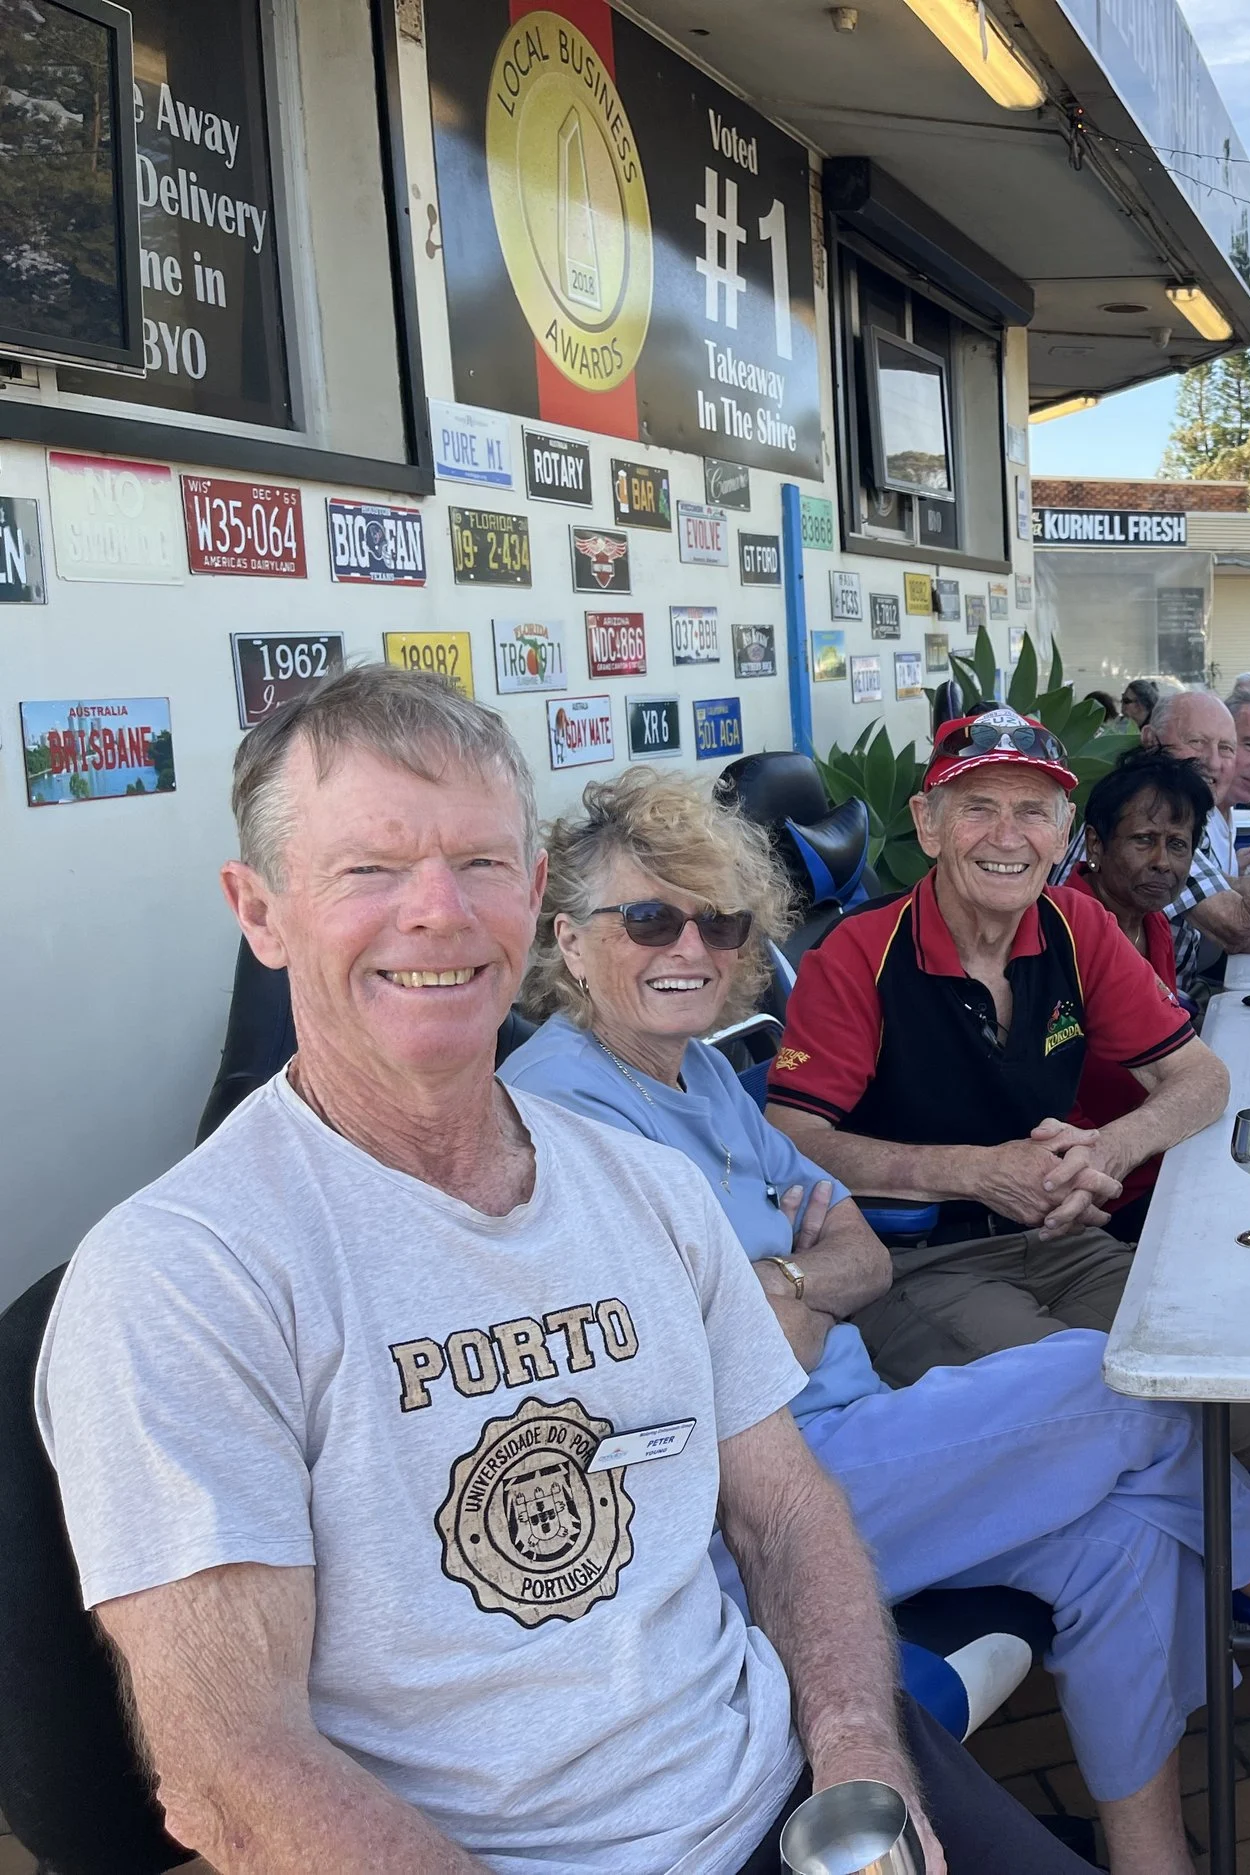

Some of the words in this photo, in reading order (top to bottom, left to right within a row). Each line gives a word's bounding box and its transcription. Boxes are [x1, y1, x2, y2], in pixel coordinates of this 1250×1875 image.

[156, 83, 240, 169] Away
[497, 31, 550, 118] LOCAL
[559, 30, 638, 184] BUSINESS
[708, 109, 759, 175] Voted
[138, 154, 267, 254] Delivery
[194, 251, 227, 308] in
[571, 269, 595, 296] 2018
[695, 166, 793, 361] #1
[143, 318, 208, 380] BYO
[545, 318, 623, 380] AWARDS
[704, 339, 786, 408] Takeaway
[697, 390, 717, 431] In
[720, 397, 753, 436] The
[756, 406, 798, 452] Shire
[442, 428, 479, 467] PURE
[533, 448, 584, 490] ROTARY
[84, 467, 145, 518] NO
[252, 487, 272, 501] DEC
[631, 477, 655, 512] BAR
[332, 513, 370, 568] BIG
[383, 518, 423, 571] FAN
[469, 511, 514, 532] FLORIDA
[1044, 511, 1126, 541] KURNELL
[1128, 516, 1186, 542] FRESH
[250, 558, 296, 573] DAIRYLAND
[743, 545, 755, 572] GT
[756, 546, 777, 573] FORD
[259, 642, 330, 681] 1962
[69, 705, 129, 718] AUSTRALIA
[642, 709, 660, 745] XR
[661, 709, 669, 742] 6
[47, 726, 155, 774] BRISBANE
[388, 1297, 639, 1413] PORTO
[645, 1447, 668, 1457] YOUNG
[646, 1435, 676, 1449] PETER
[464, 1426, 541, 1513] UNIVERSIDADE
[548, 1425, 566, 1445] DO
[520, 1559, 603, 1598] PORTUGAL
